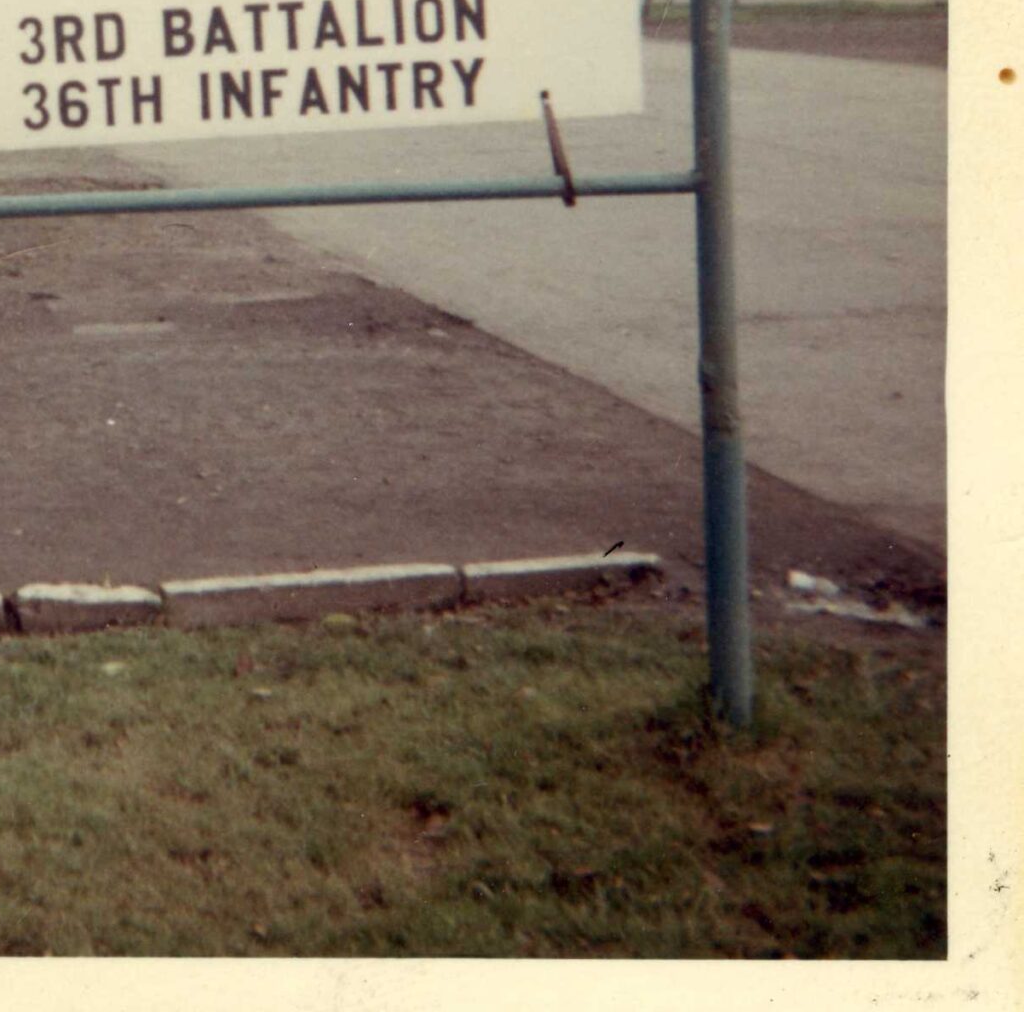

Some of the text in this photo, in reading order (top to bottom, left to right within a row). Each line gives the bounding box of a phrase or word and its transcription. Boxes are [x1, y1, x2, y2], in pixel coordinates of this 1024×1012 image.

[18, 12, 126, 65] 3RD
[22, 57, 485, 131] 36TH INFANTRY
